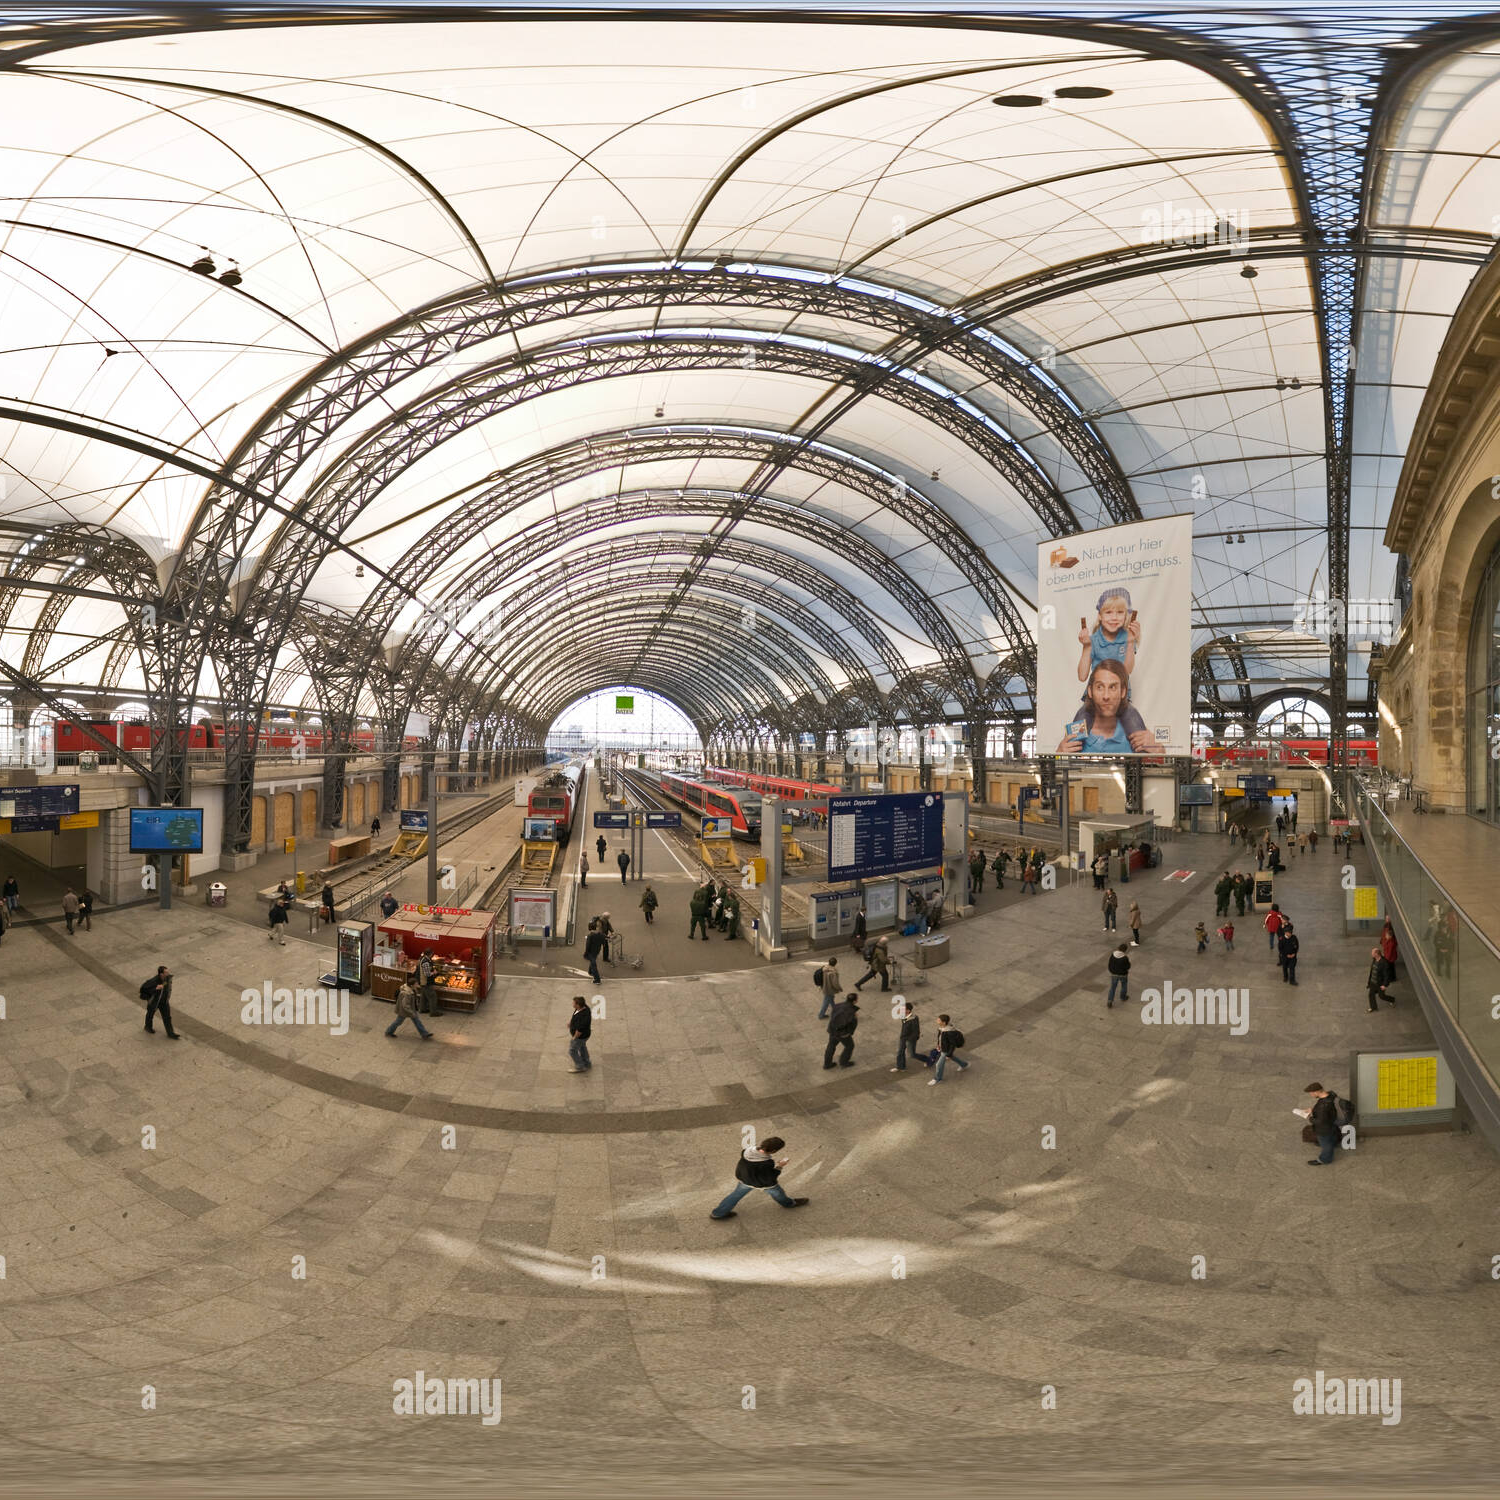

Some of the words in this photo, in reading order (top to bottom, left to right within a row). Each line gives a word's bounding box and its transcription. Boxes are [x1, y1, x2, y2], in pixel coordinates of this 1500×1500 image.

[1082, 545, 1113, 561] Nicht
[1116, 544, 1136, 555] nur
[1139, 538, 1163, 551] hier
[1046, 571, 1075, 587] oben
[1077, 567, 1095, 580] ein
[1098, 555, 1182, 577] Hochgenuss.
